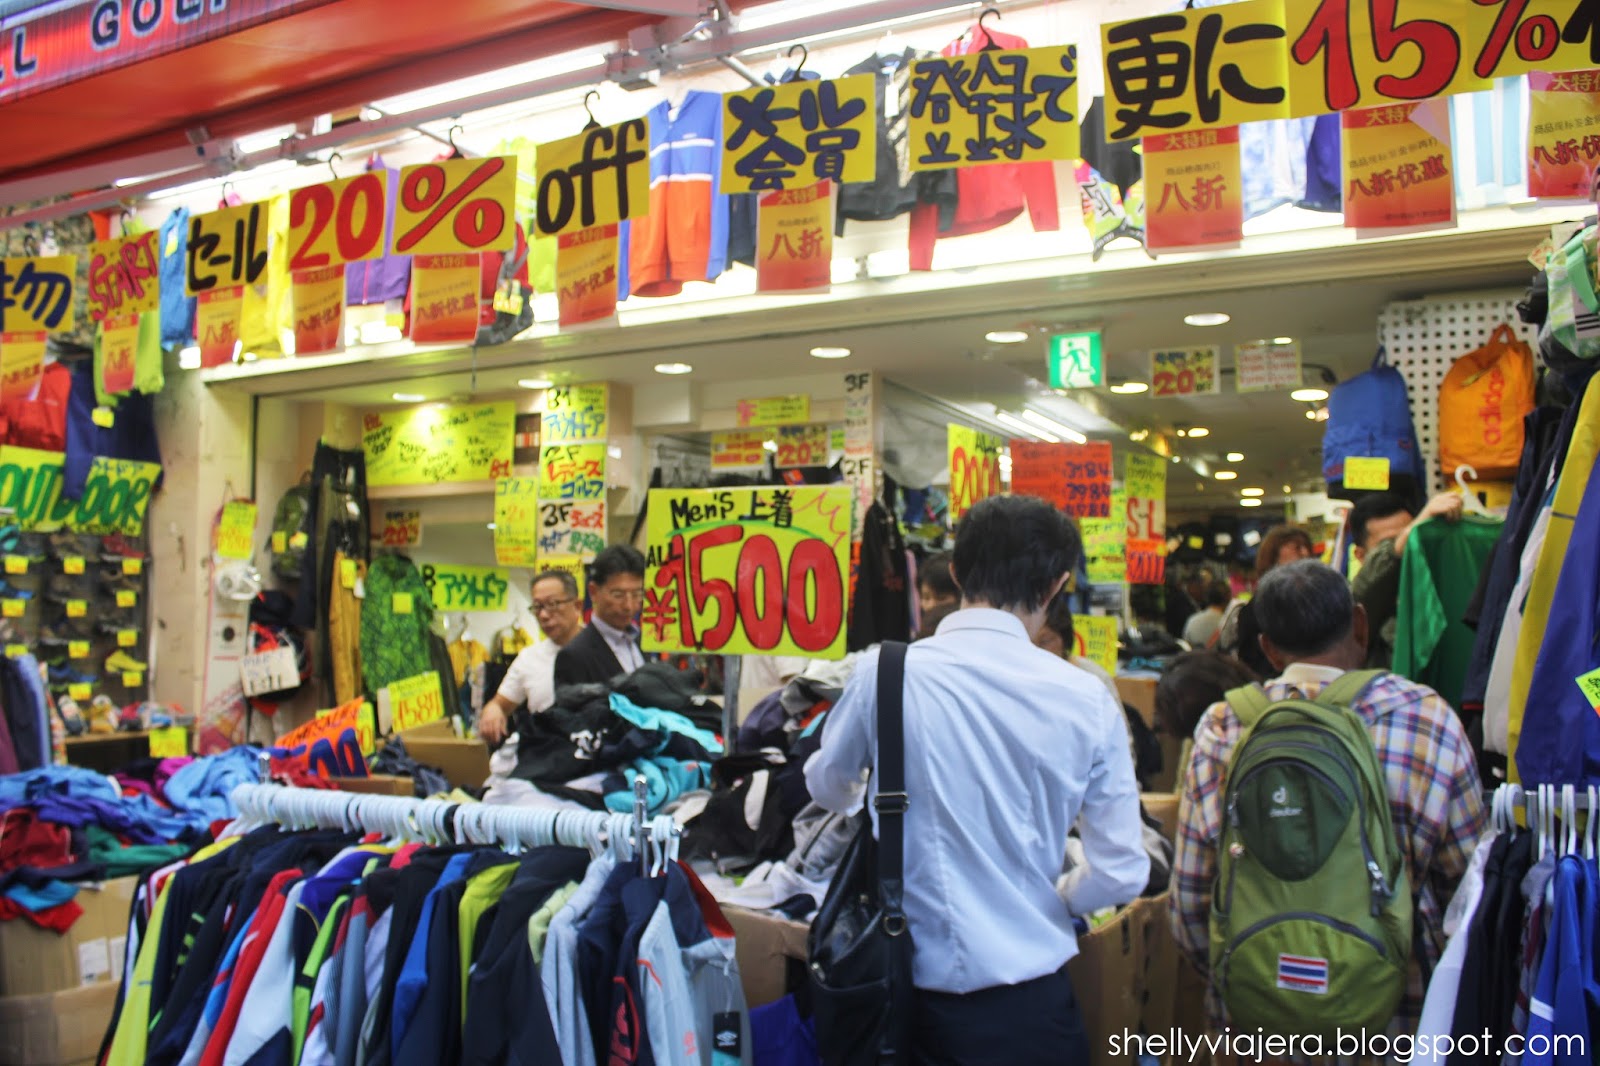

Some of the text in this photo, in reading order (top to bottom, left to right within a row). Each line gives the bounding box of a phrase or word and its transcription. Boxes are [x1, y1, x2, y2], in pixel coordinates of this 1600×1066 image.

[91, 0, 225, 48] GO
[1107, 13, 1286, 141] 更に
[911, 45, 1077, 164] 登録で
[536, 118, 647, 235] off
[1156, 174, 1227, 214] 八折
[186, 204, 269, 292] セール
[767, 227, 825, 261] 八折
[89, 231, 159, 321] START
[844, 373, 870, 392] 3F
[845, 458, 871, 476] 2F
[540, 502, 574, 528] 3F
[739, 489, 793, 529] 上着
[646, 544, 682, 569] ALL
